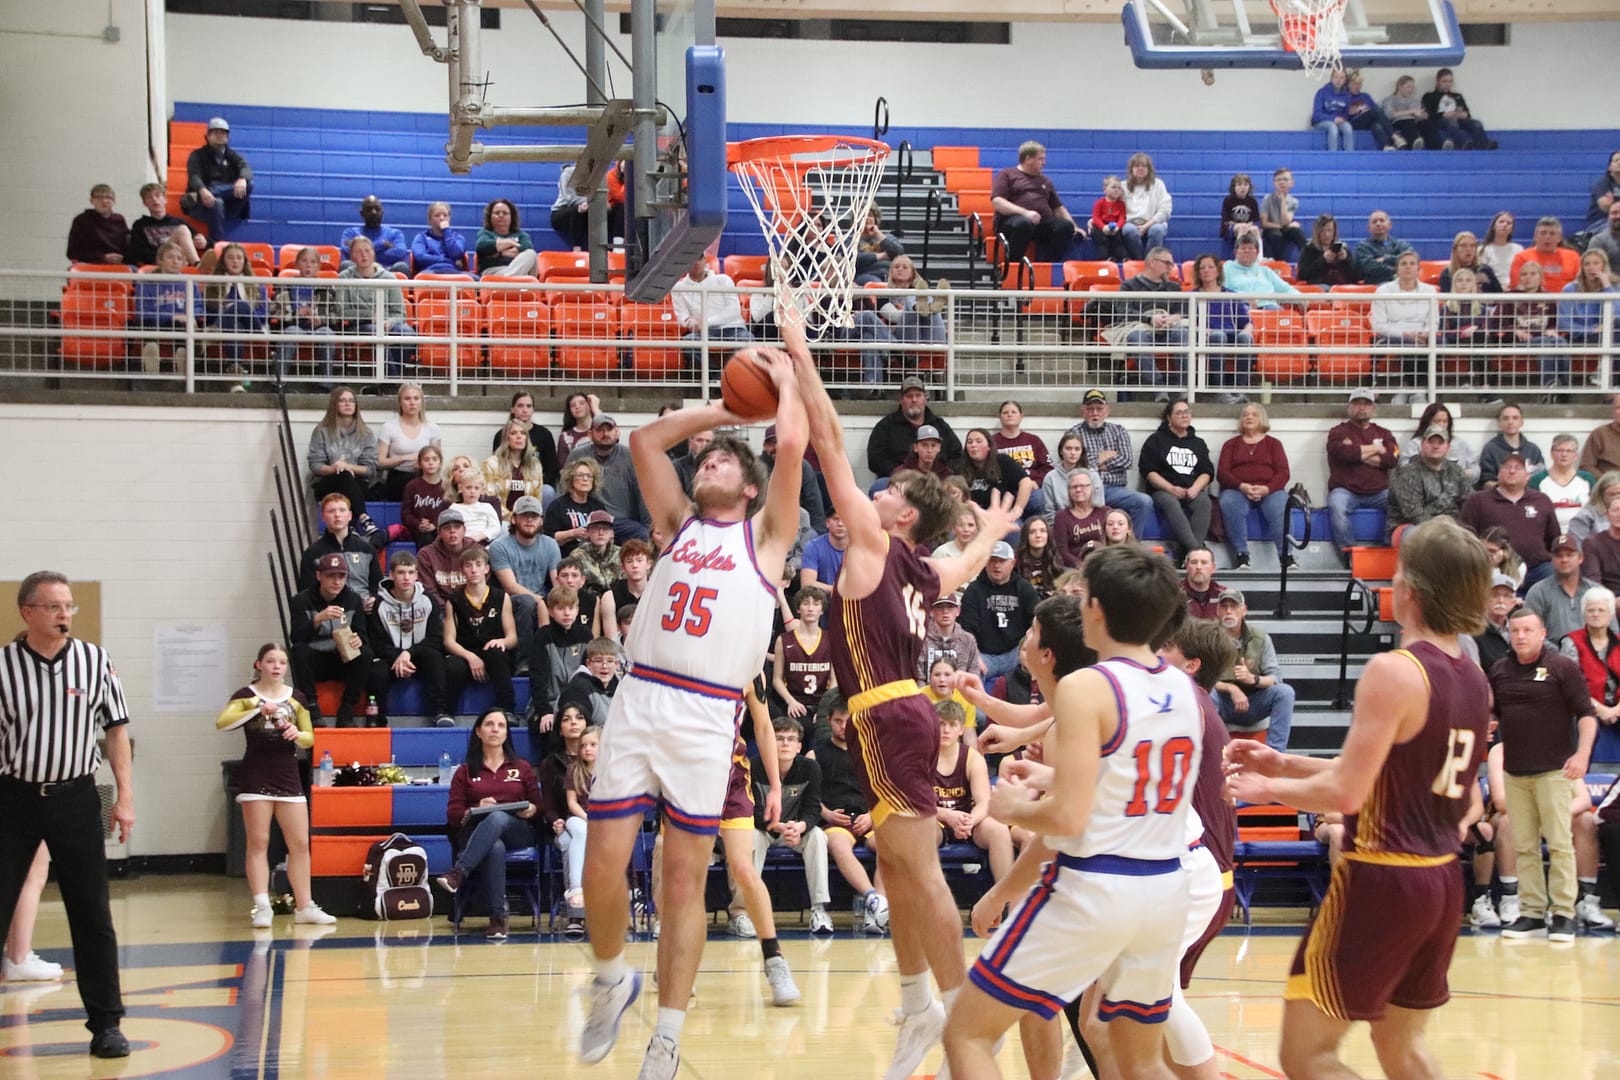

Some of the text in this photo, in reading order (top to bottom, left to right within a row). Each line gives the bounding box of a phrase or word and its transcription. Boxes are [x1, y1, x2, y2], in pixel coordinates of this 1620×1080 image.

[672, 538, 736, 574] Eagles
[661, 581, 719, 637] 35
[789, 661, 830, 672] DIETERICH
[803, 674, 817, 694] 3
[1125, 736, 1195, 817] 10
[1431, 728, 1475, 799] 12
